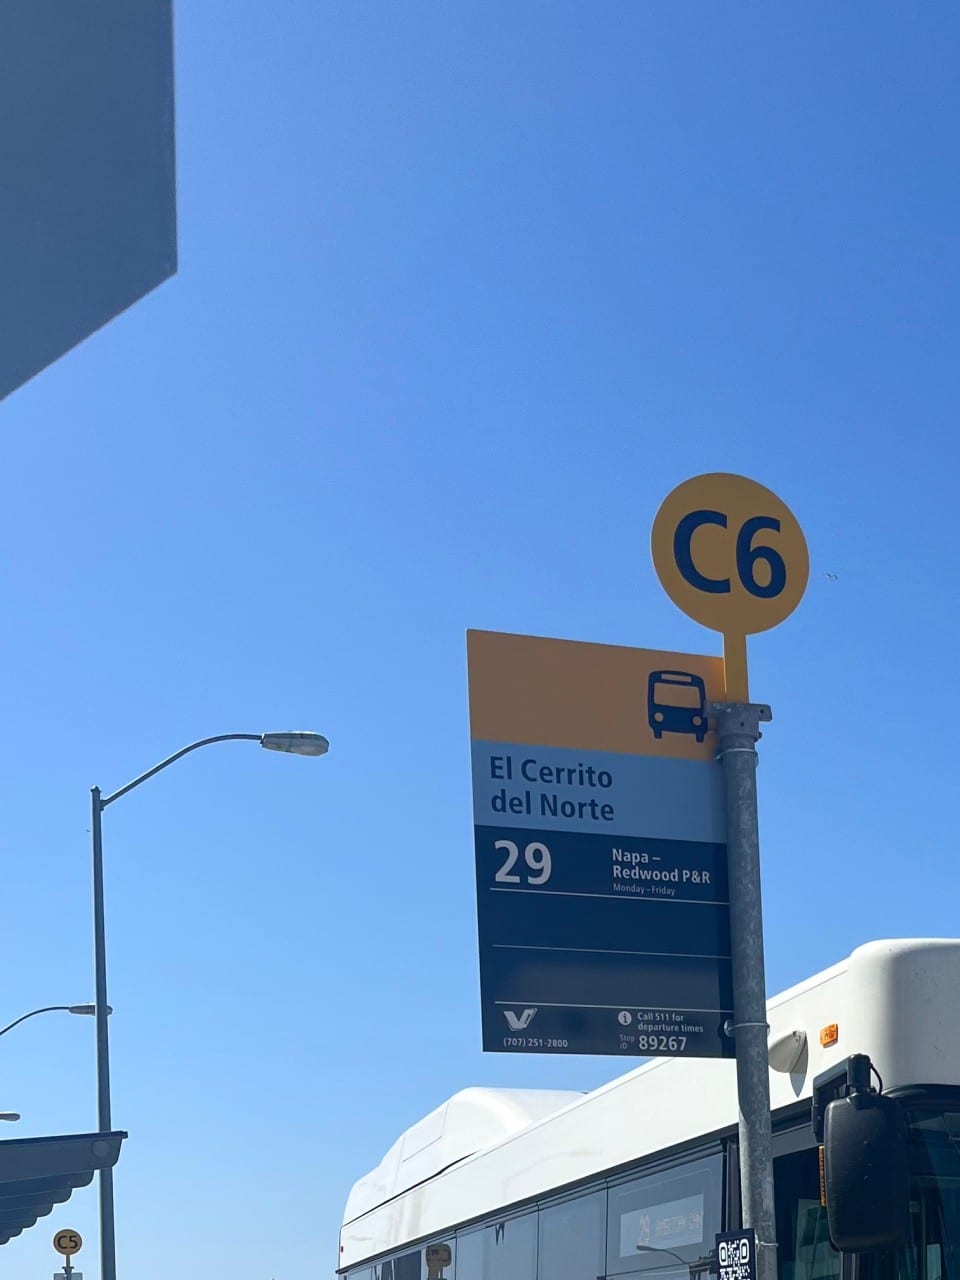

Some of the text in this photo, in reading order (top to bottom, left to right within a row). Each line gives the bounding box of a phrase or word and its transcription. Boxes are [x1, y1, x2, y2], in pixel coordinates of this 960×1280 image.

[673, 510, 787, 598] C6
[490, 756, 613, 788] El Cerrito
[491, 788, 614, 821] del Norte
[494, 840, 552, 885] 29
[612, 848, 649, 866] Napa
[613, 865, 710, 885] Redwood P&R
[637, 1012, 684, 1022] Call 511 for
[637, 1022, 704, 1033] departure times
[503, 1037, 526, 1048] (707)
[639, 1035, 687, 1051] 89267
[57, 1235, 78, 1249] C5
